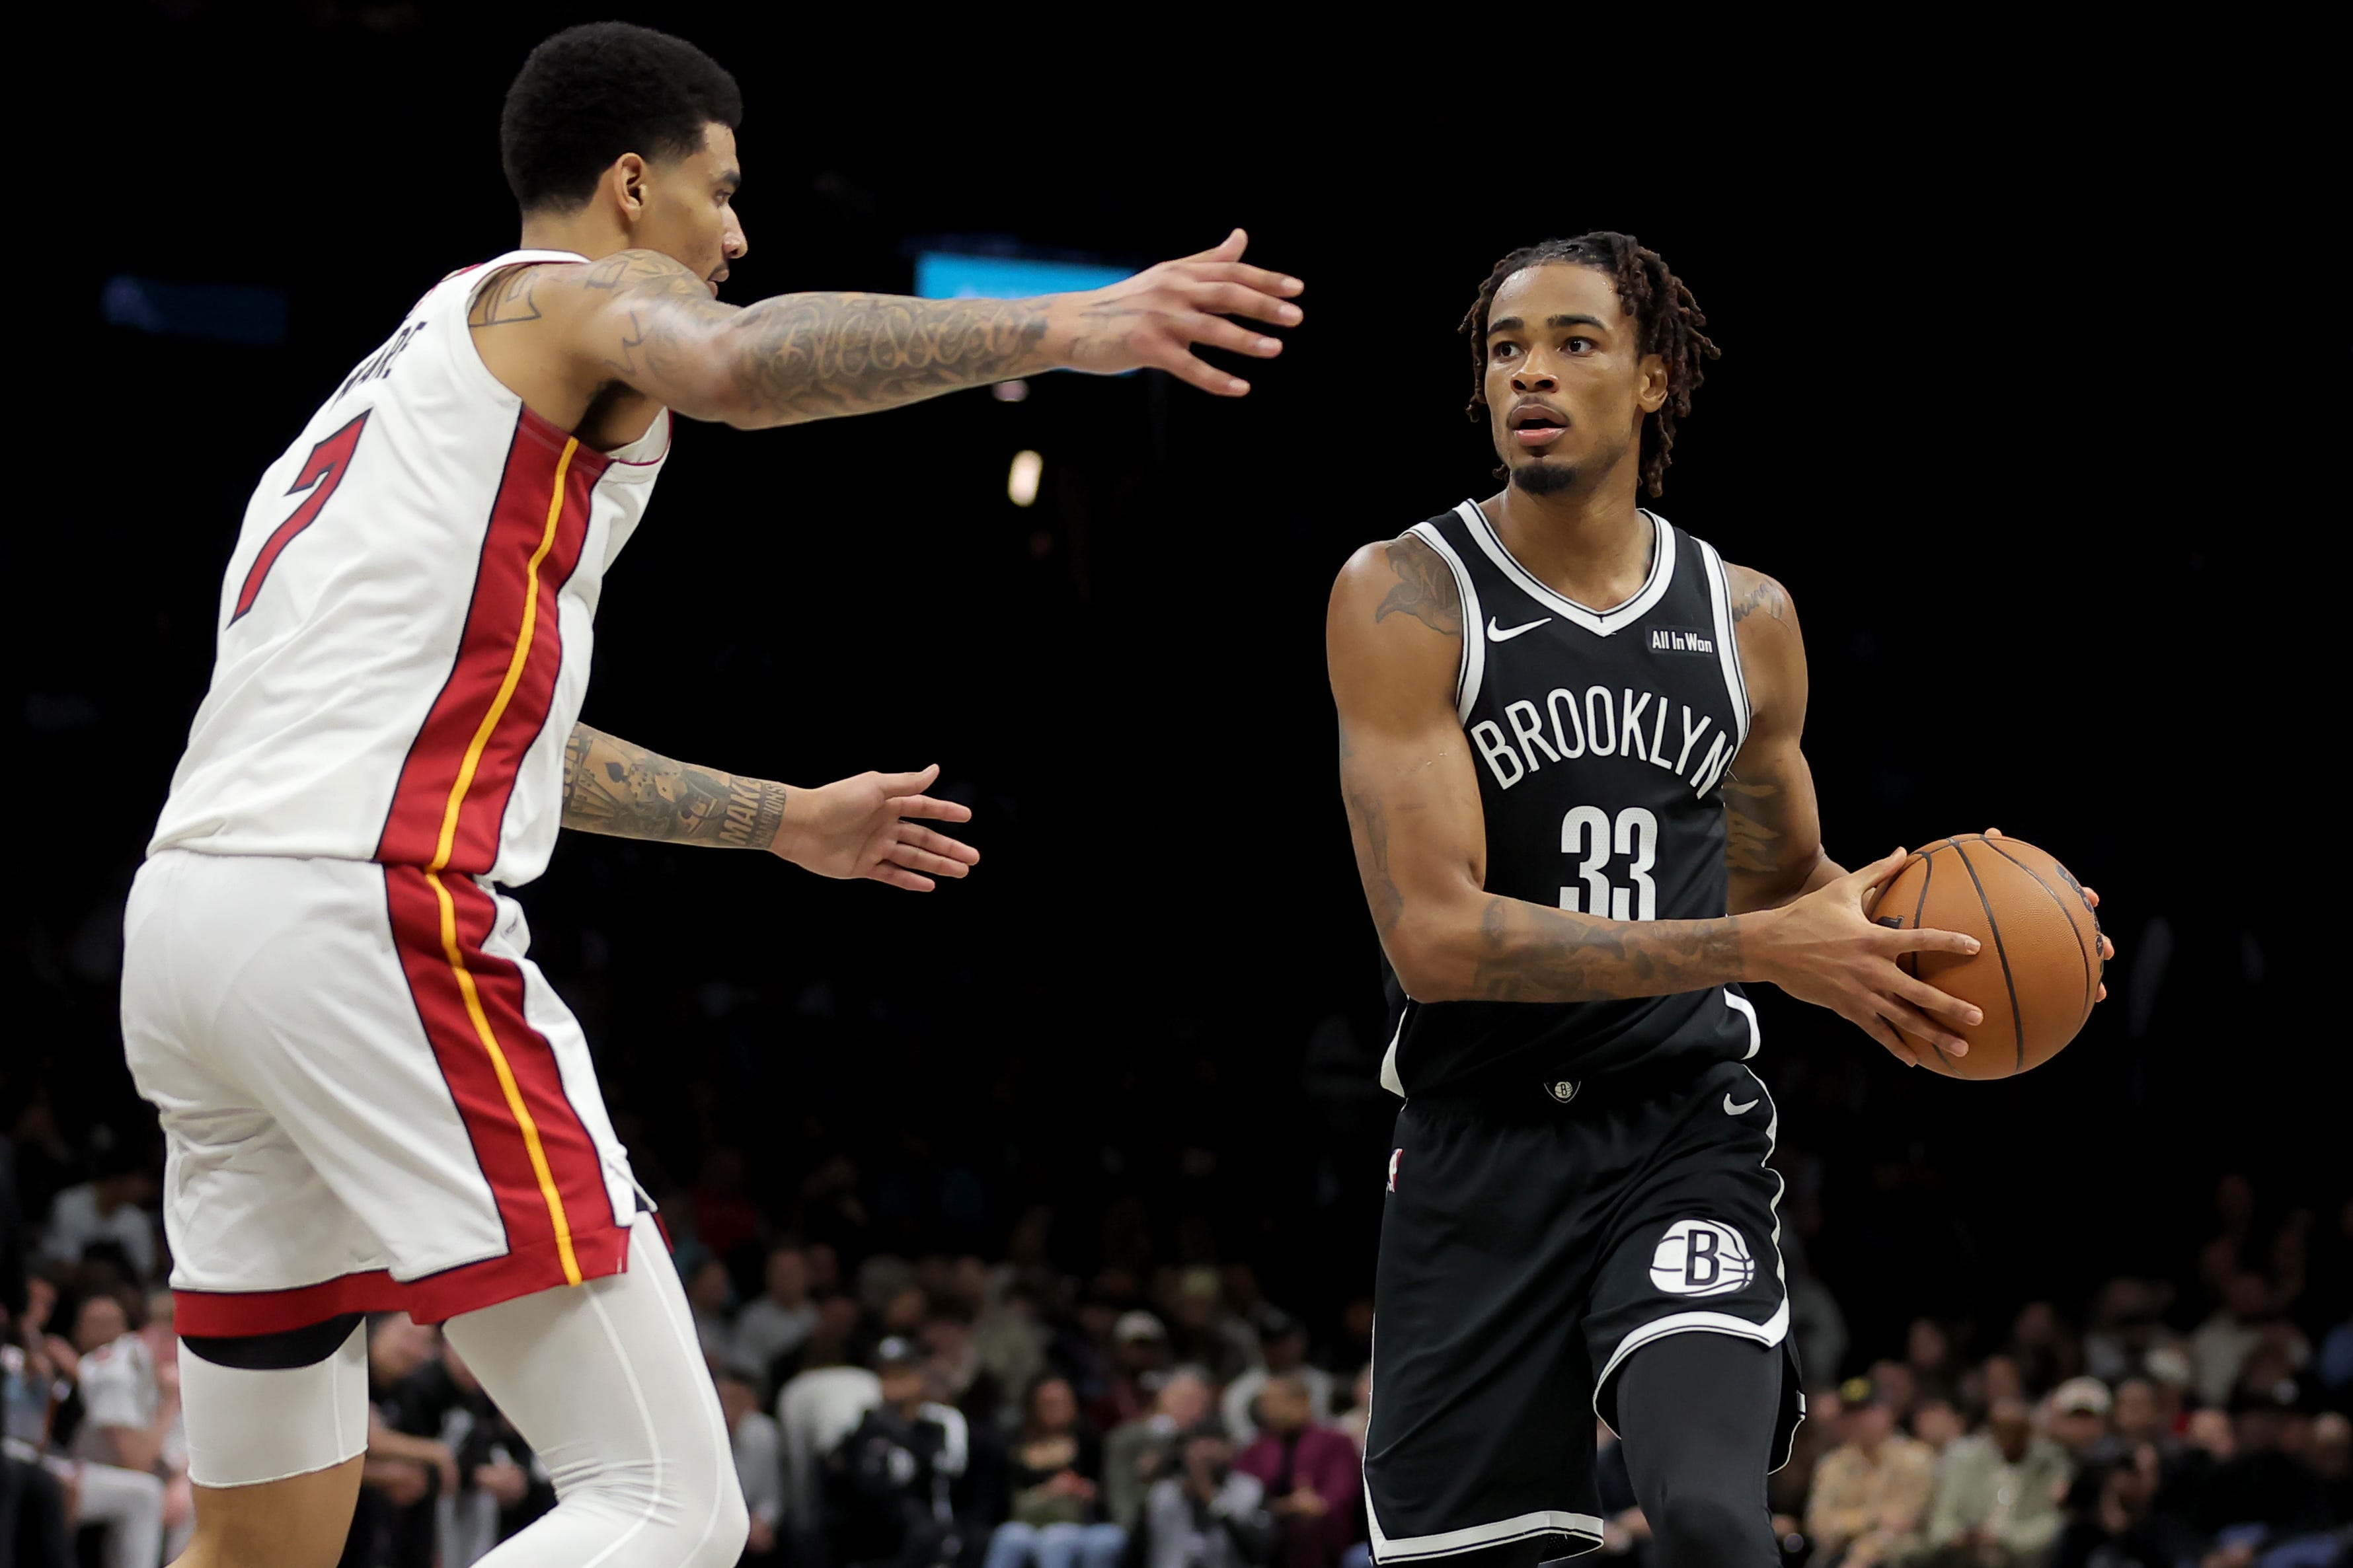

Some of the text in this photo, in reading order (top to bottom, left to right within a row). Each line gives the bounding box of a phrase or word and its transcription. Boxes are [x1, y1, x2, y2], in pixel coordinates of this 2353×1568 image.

[225, 406, 374, 631] 7
[1652, 630, 1713, 653] All In Won
[1470, 685, 1734, 801] BROOKLYN
[1559, 805, 1658, 922] 33
[1685, 1229, 1720, 1286] B
